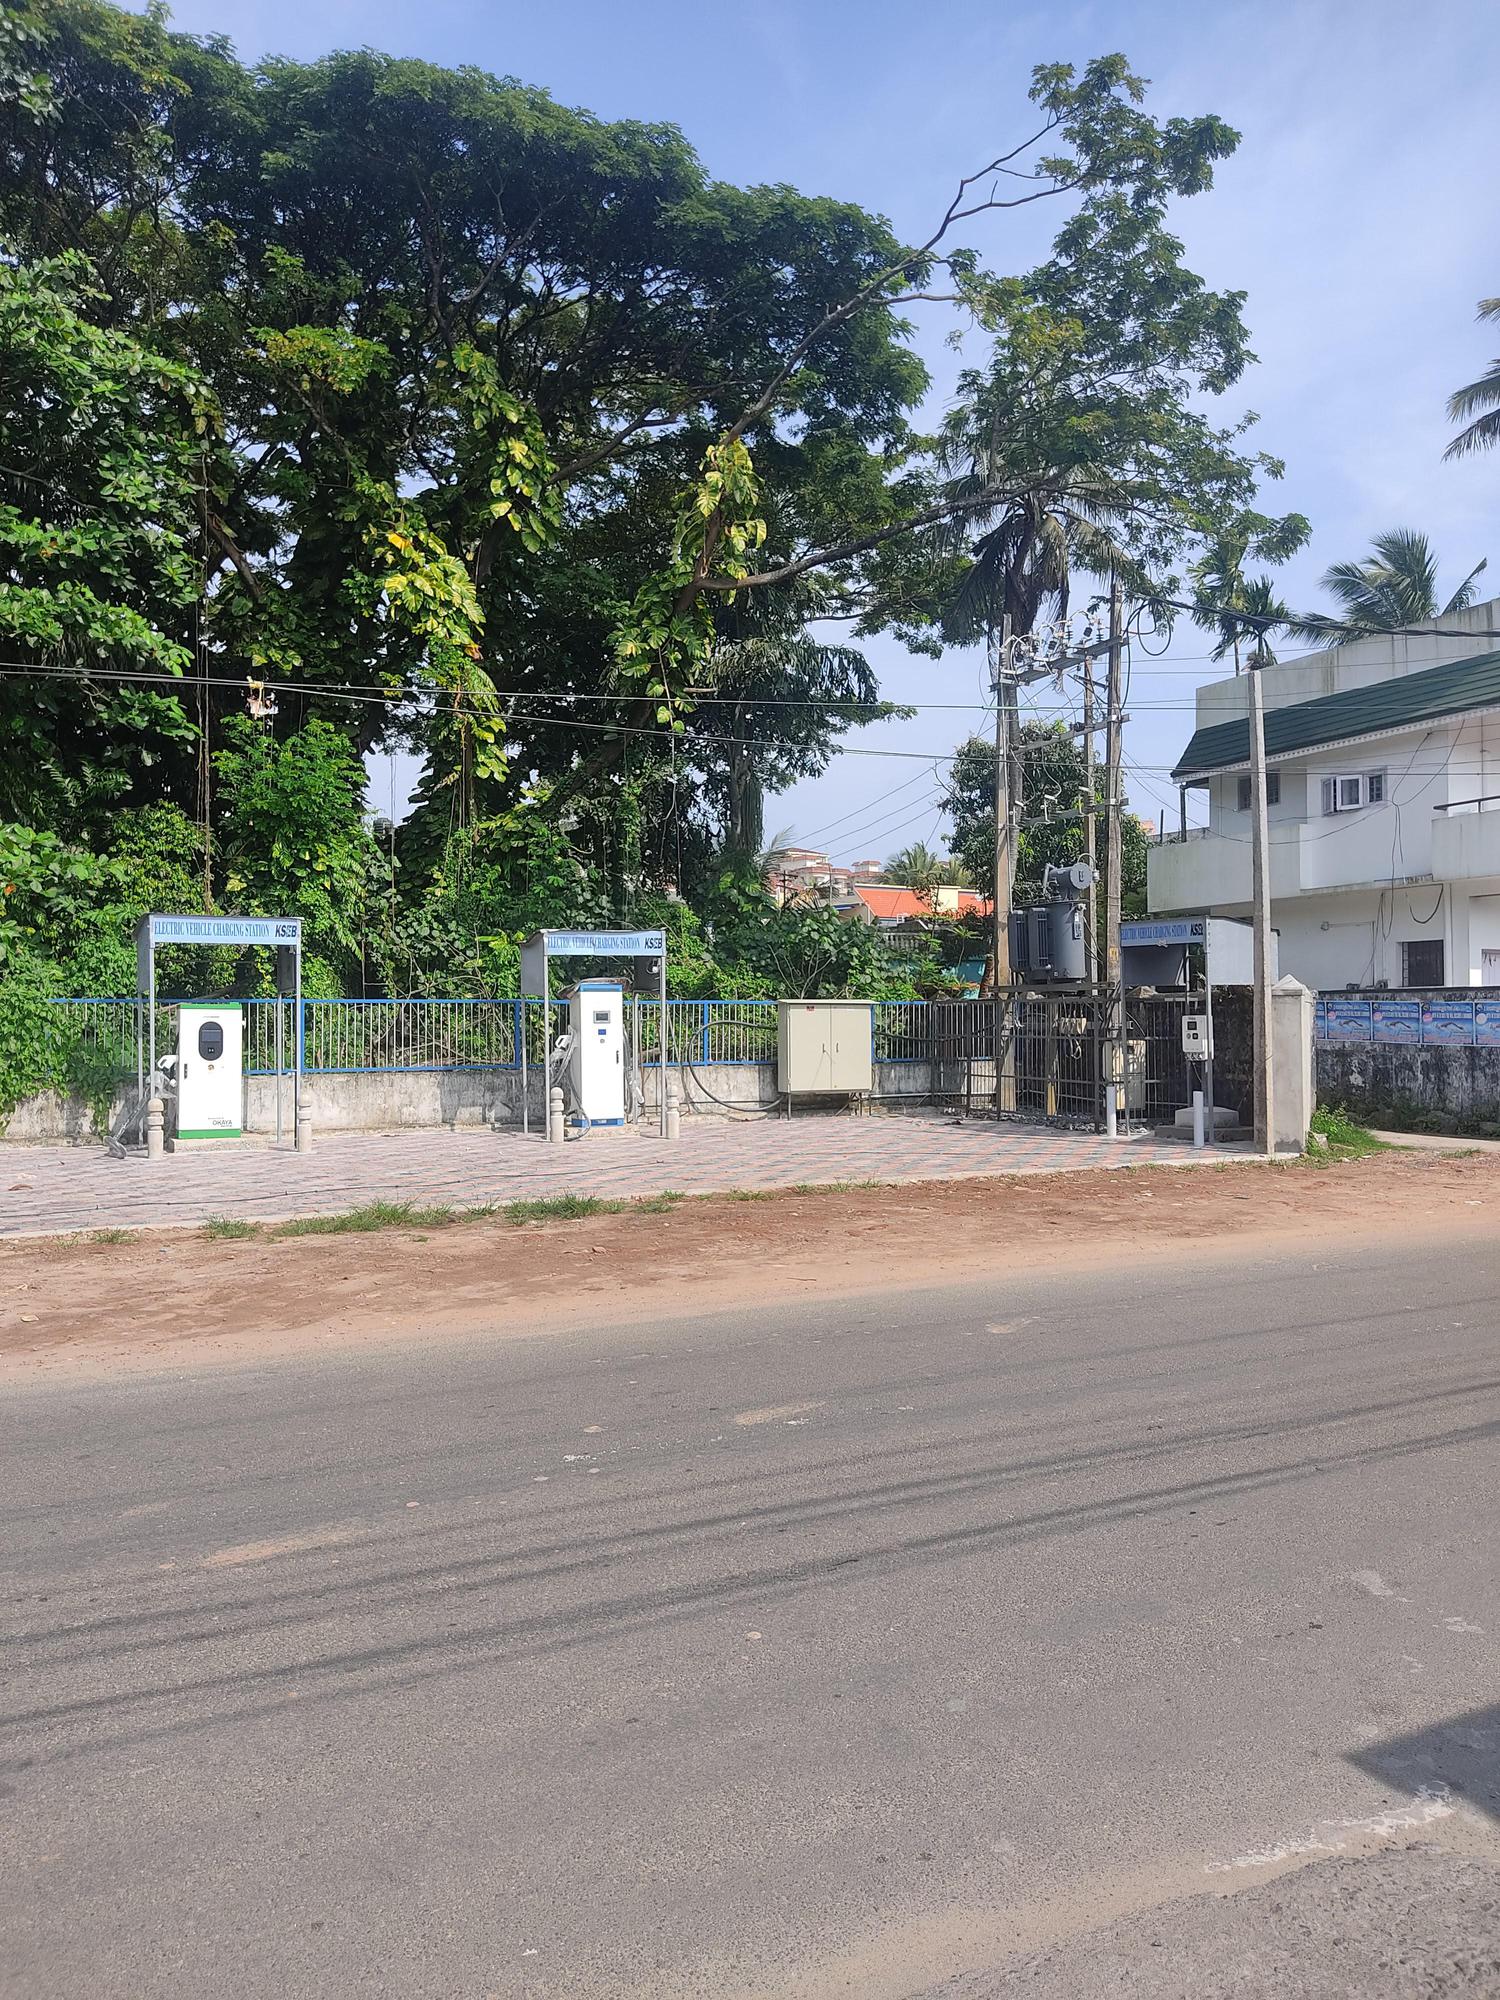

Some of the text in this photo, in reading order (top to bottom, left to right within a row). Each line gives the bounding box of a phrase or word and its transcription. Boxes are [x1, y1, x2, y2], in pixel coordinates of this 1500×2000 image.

[154, 922, 298, 938] ELECTRIC VEHICLE CHARGING STATION KSEB
[645, 938, 662, 949] KSEB
